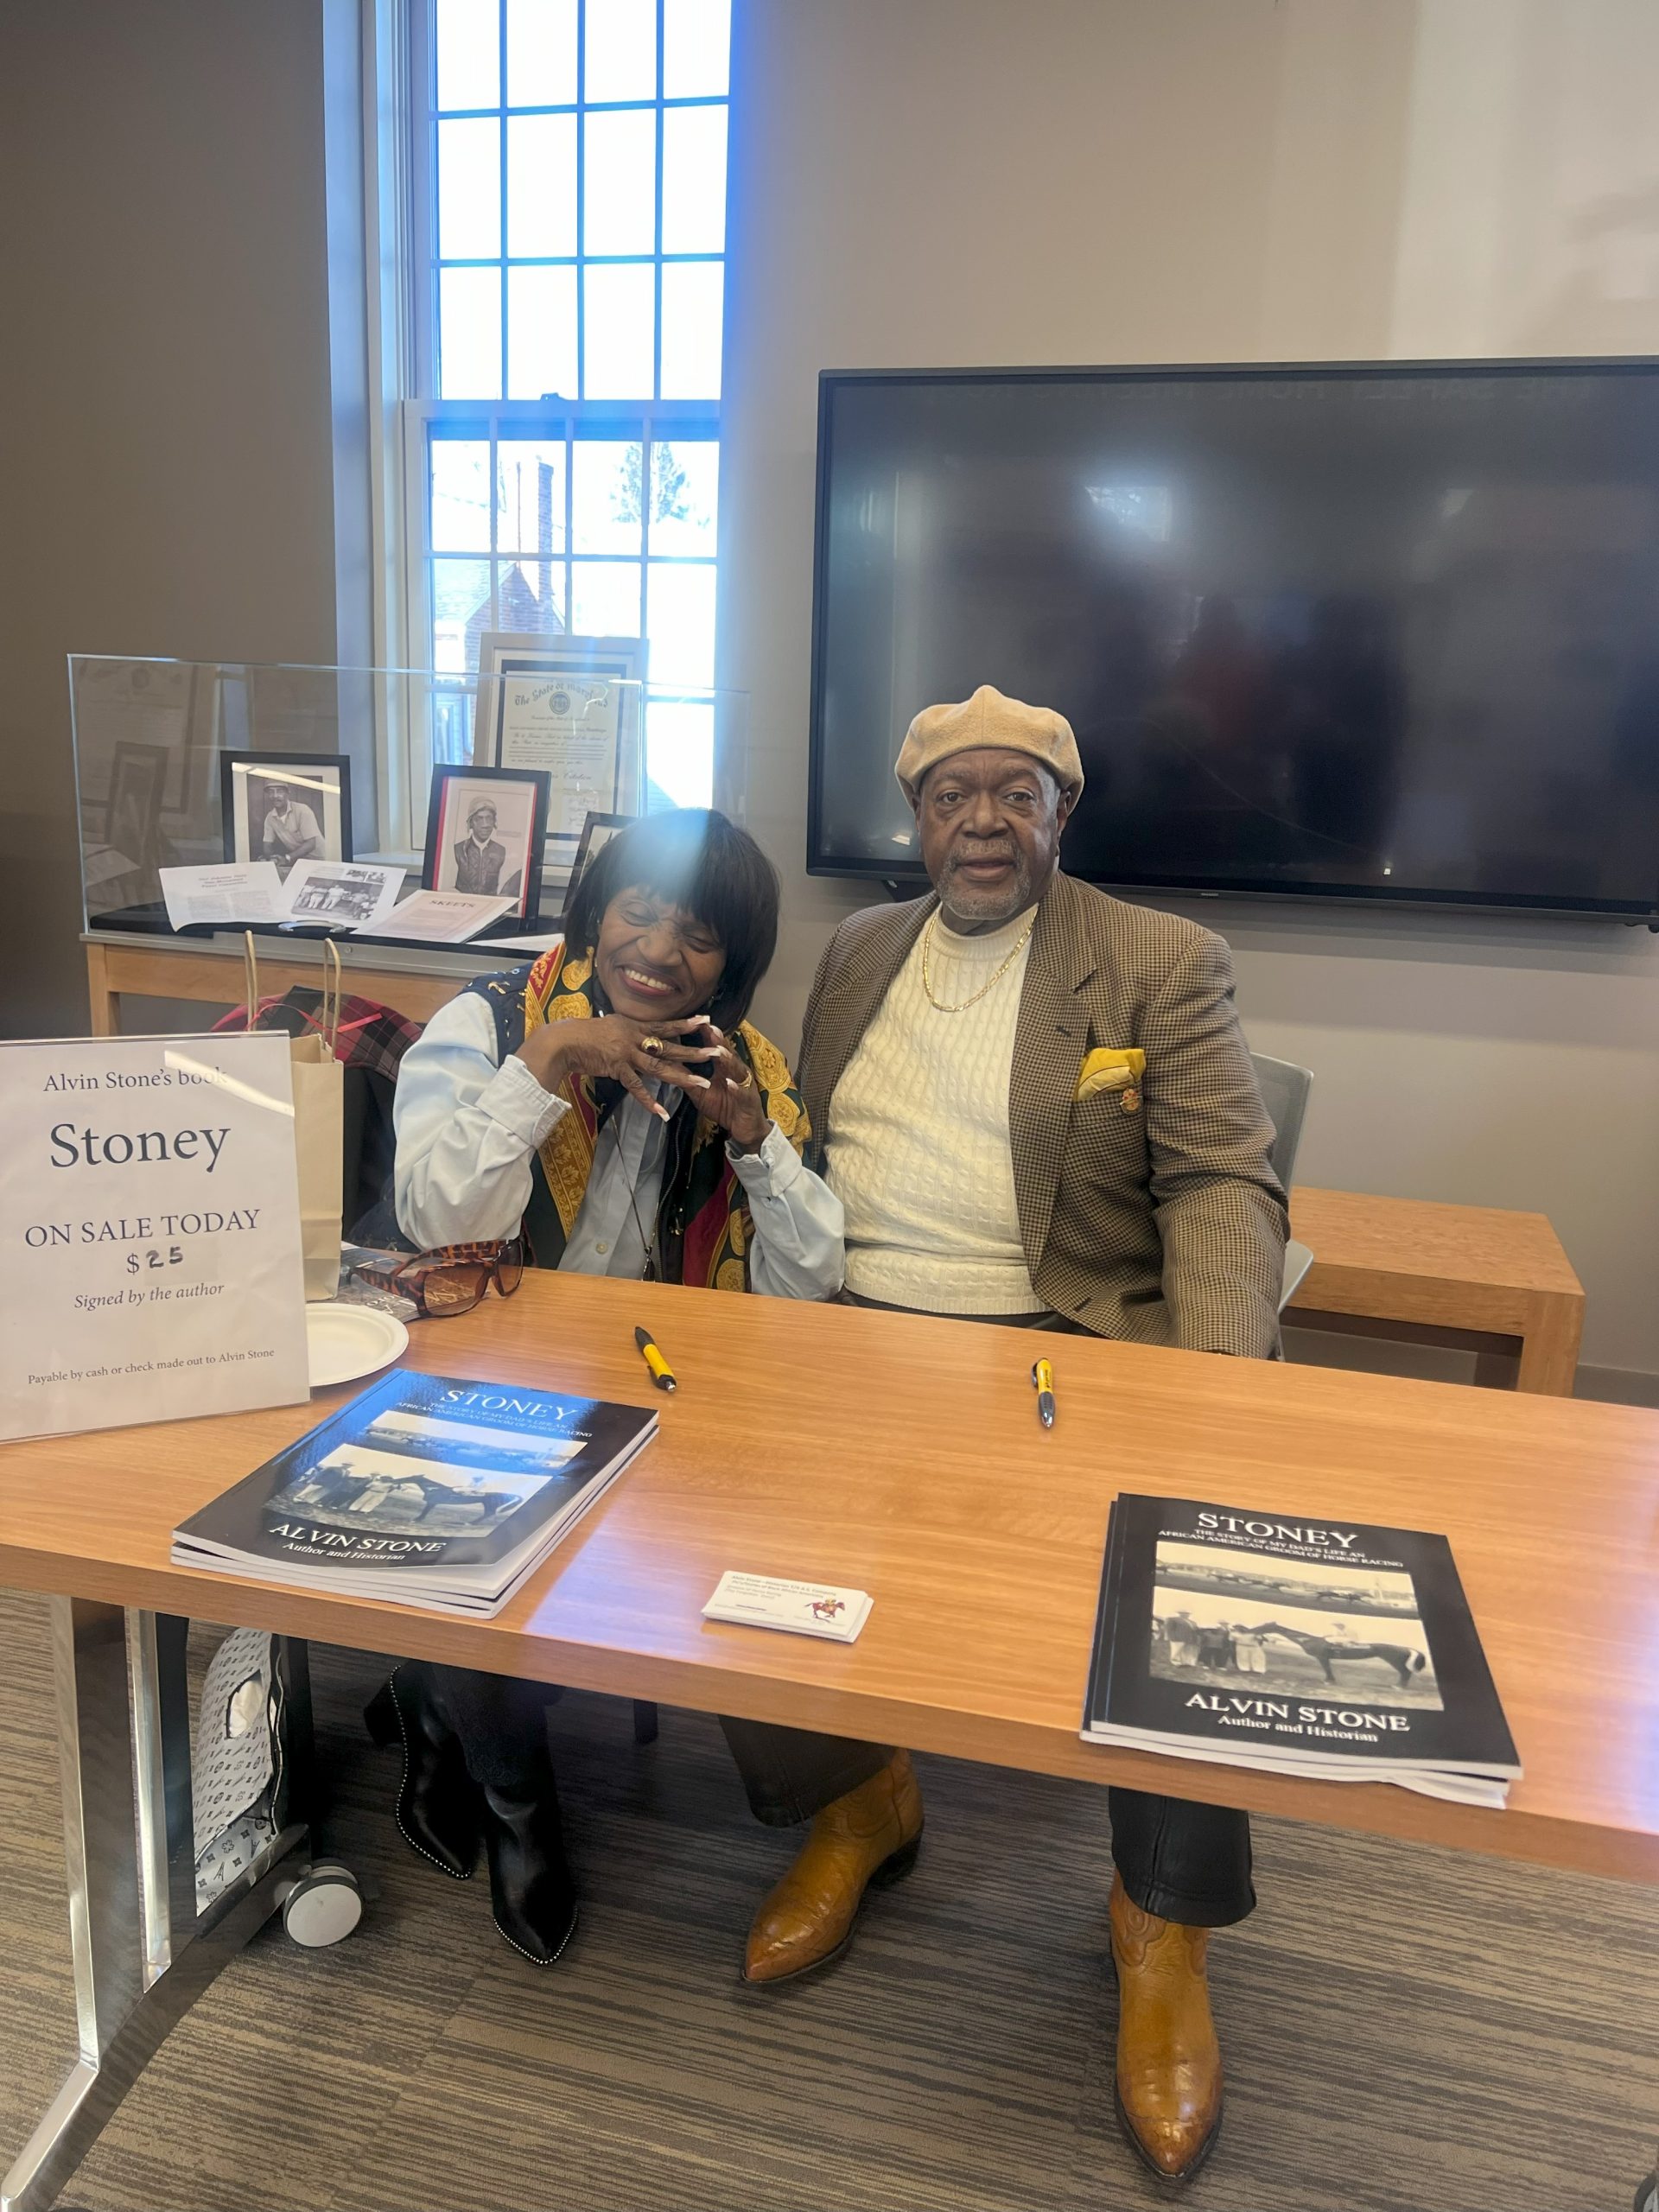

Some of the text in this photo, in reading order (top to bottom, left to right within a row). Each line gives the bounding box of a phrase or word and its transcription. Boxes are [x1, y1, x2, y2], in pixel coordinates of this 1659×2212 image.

[514, 694, 530, 706] The
[43, 1066, 228, 1091] Alvin Stone's book
[50, 1123, 232, 1173] Stoney
[25, 1209, 260, 1247] ON SALE TODAY
[74, 1282, 224, 1311] Signed by the author
[28, 1349, 275, 1385] Payable by cash or check made out to Alvin Stone
[396, 1402, 434, 1412] AFRICAN
[440, 1389, 579, 1421] STONEY
[270, 1523, 446, 1552] ALVIN STONE
[1198, 1512, 1359, 1548] STONEY
[1217, 1532, 1252, 1542] STORY
[283, 1541, 406, 1560] Author and Historian
[1158, 1530, 1205, 1541] AFRICAN
[1206, 1536, 1263, 1549] AMERICAN
[1264, 1545, 1306, 1557] GROOM
[1323, 1554, 1360, 1563] HORSE
[1361, 1559, 1403, 1567] RACING
[1184, 1691, 1411, 1732] ALVIN STONE
[1217, 1715, 1378, 1742] Author and Historian
